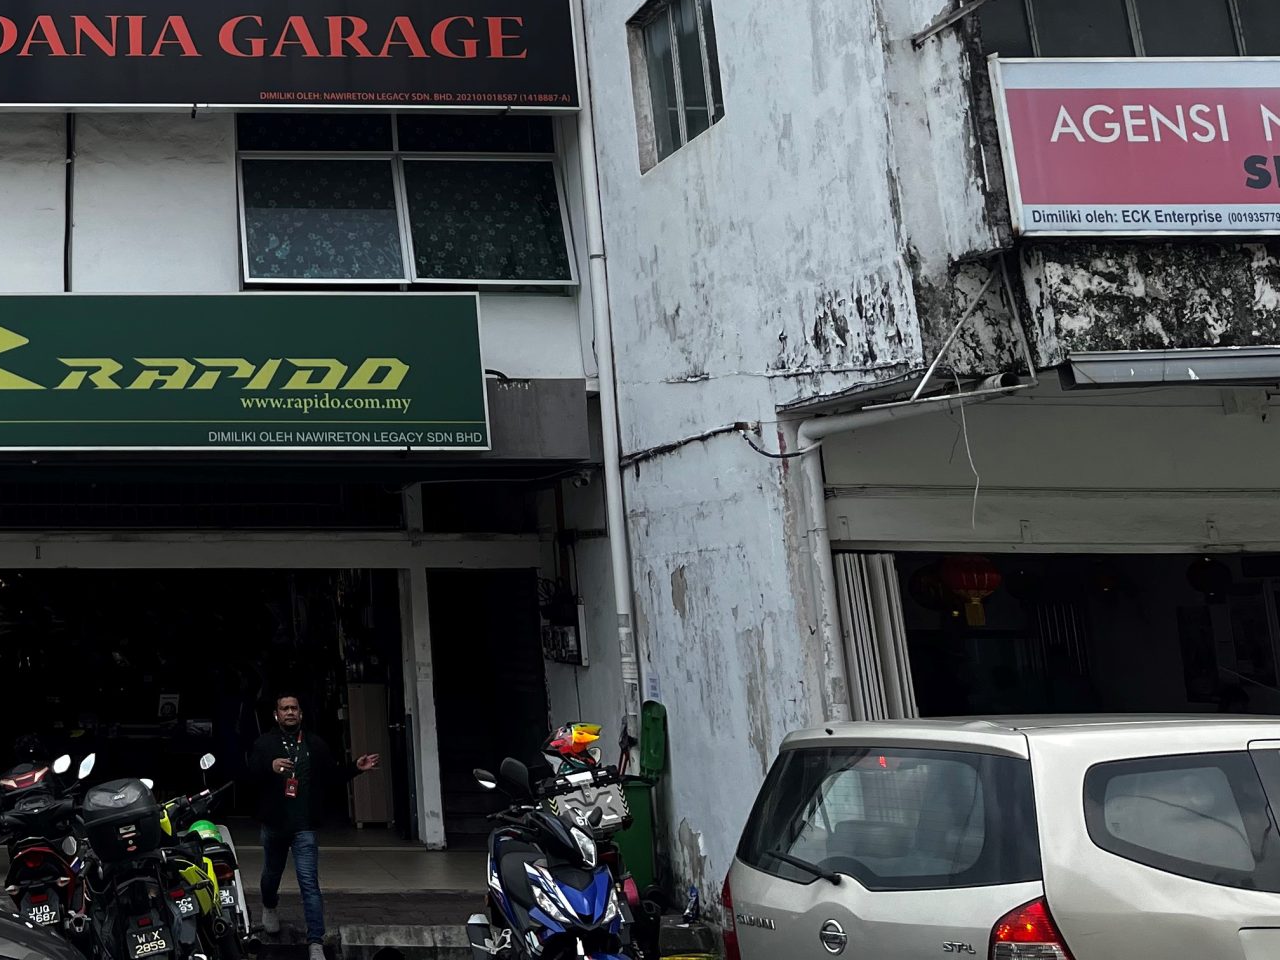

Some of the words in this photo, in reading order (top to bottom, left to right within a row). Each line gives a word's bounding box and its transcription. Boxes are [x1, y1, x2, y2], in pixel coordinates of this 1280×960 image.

[218, 15, 529, 59] GARAGE
[260, 92, 295, 100] DIMILIKI
[323, 92, 375, 101] NAWIRETON
[376, 92, 409, 101] LEGACY
[1050, 104, 1229, 143] AGENSI
[1032, 209, 1082, 223] Dimiliki
[1085, 209, 1119, 223] oleh:
[1121, 210, 1152, 223] ECK
[1154, 209, 1223, 226] Enterprise
[54, 357, 410, 390] RAPIDO
[240, 393, 412, 413] www.rapido.com.my
[208, 431, 256, 442] DIMILIKI
[259, 431, 293, 442] OLEH
[296, 431, 370, 442] NAWIRETON
[373, 431, 424, 442] LEGACY
[426, 431, 453, 442] SDN
[456, 431, 483, 442] BHD
[28, 904, 50, 916] JUQ
[135, 939, 166, 955] 2859
